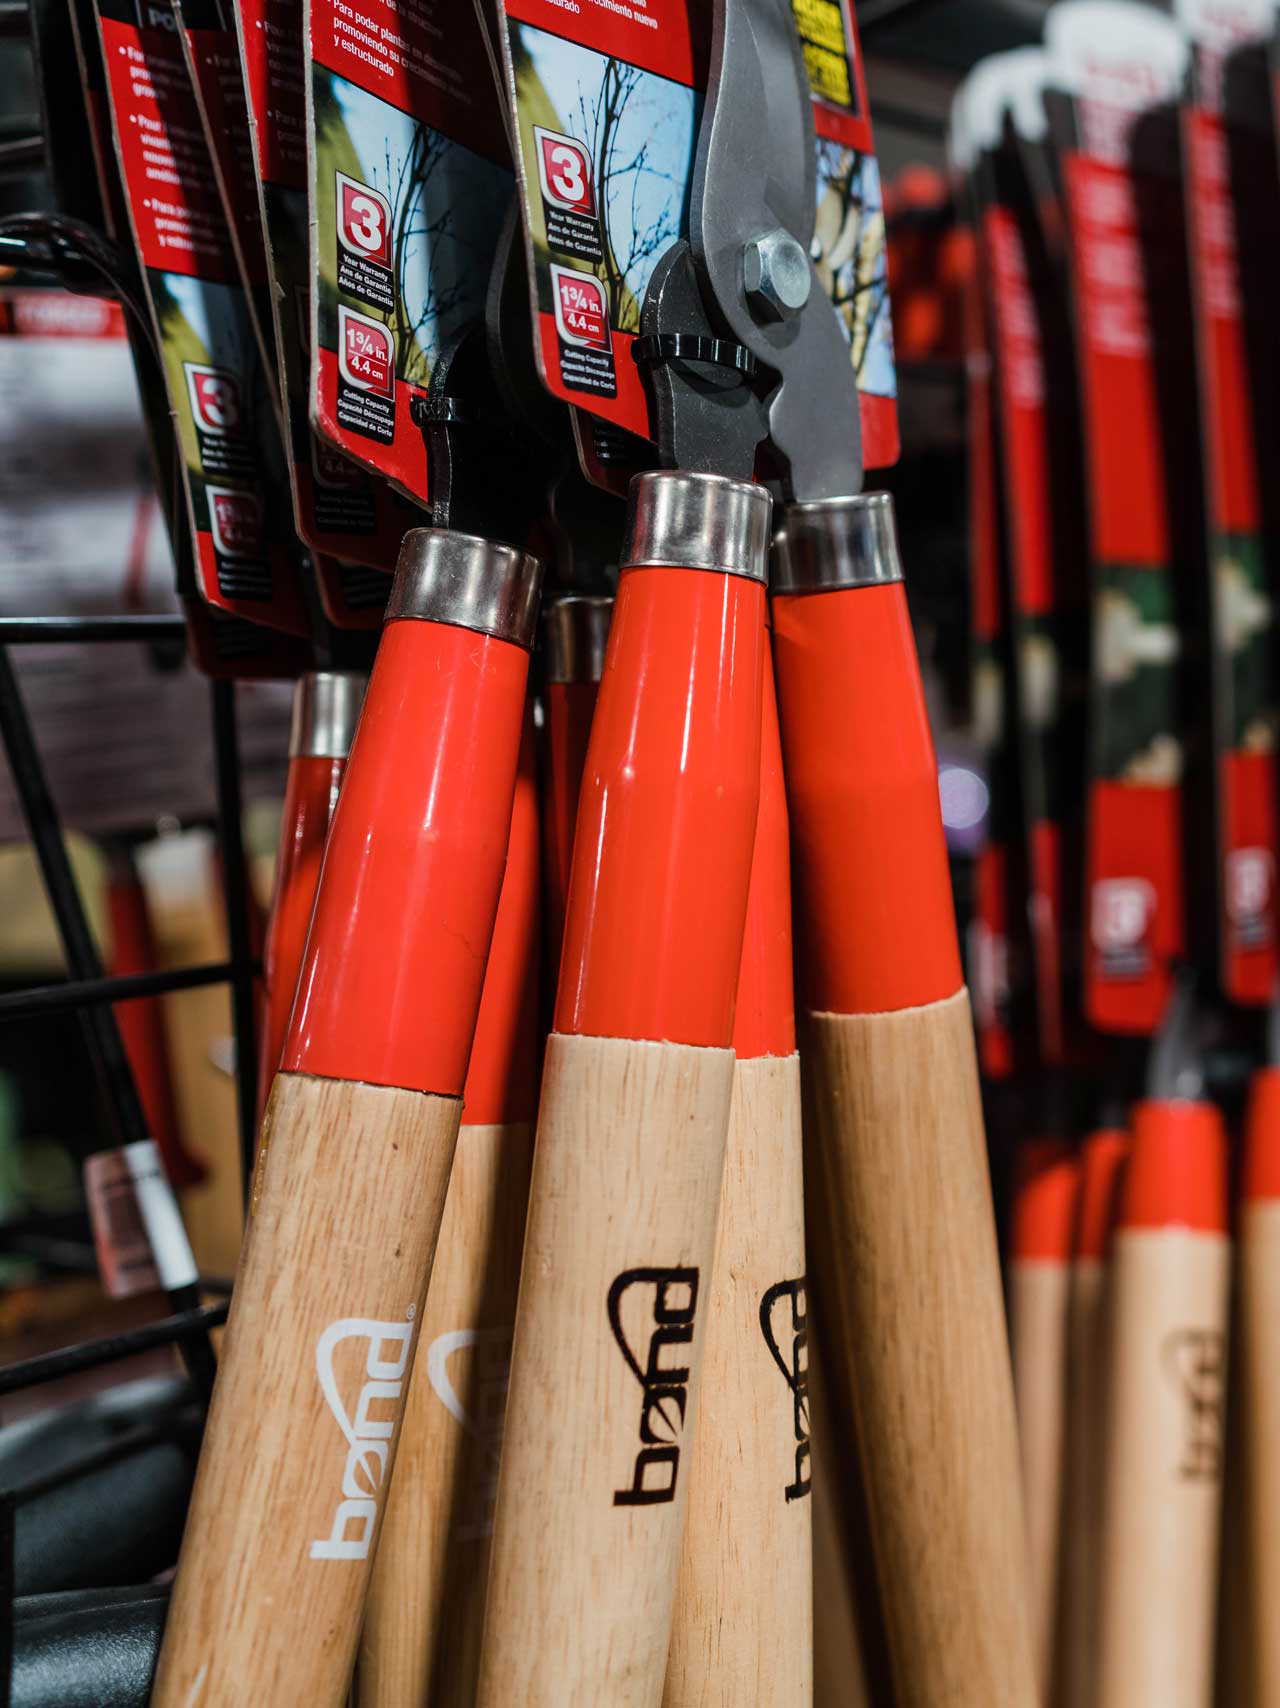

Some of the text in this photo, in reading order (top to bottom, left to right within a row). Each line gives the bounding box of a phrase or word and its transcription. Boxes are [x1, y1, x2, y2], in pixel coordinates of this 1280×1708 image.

[333, 0, 353, 18] Para
[355, 11, 379, 33] podar
[381, 27, 410, 51] plantas
[634, 11, 658, 29] nuevo
[333, 17, 388, 56] promoviendo
[389, 50, 400, 63] su
[333, 34, 340, 47] y
[341, 38, 395, 77] estructurado
[551, 146, 585, 201] 3
[350, 196, 382, 251] 3
[549, 209, 595, 232] Year Warranty
[562, 226, 571, 235] de
[571, 227, 599, 244] Garantie
[565, 239, 574, 249] de
[340, 265, 392, 295] Ans de Garantie
[343, 254, 388, 283] Year Warranty
[356, 284, 366, 295] de
[588, 299, 602, 313] in.
[567, 313, 600, 334] 4.4 cm
[375, 346, 388, 362] in.
[585, 354, 609, 368] Capacity
[351, 356, 384, 380] 4.4 cm
[337, 398, 363, 415] Capacité
[343, 389, 390, 414] Cutting Capacity
[338, 410, 393, 438] Capacidad de Corte
